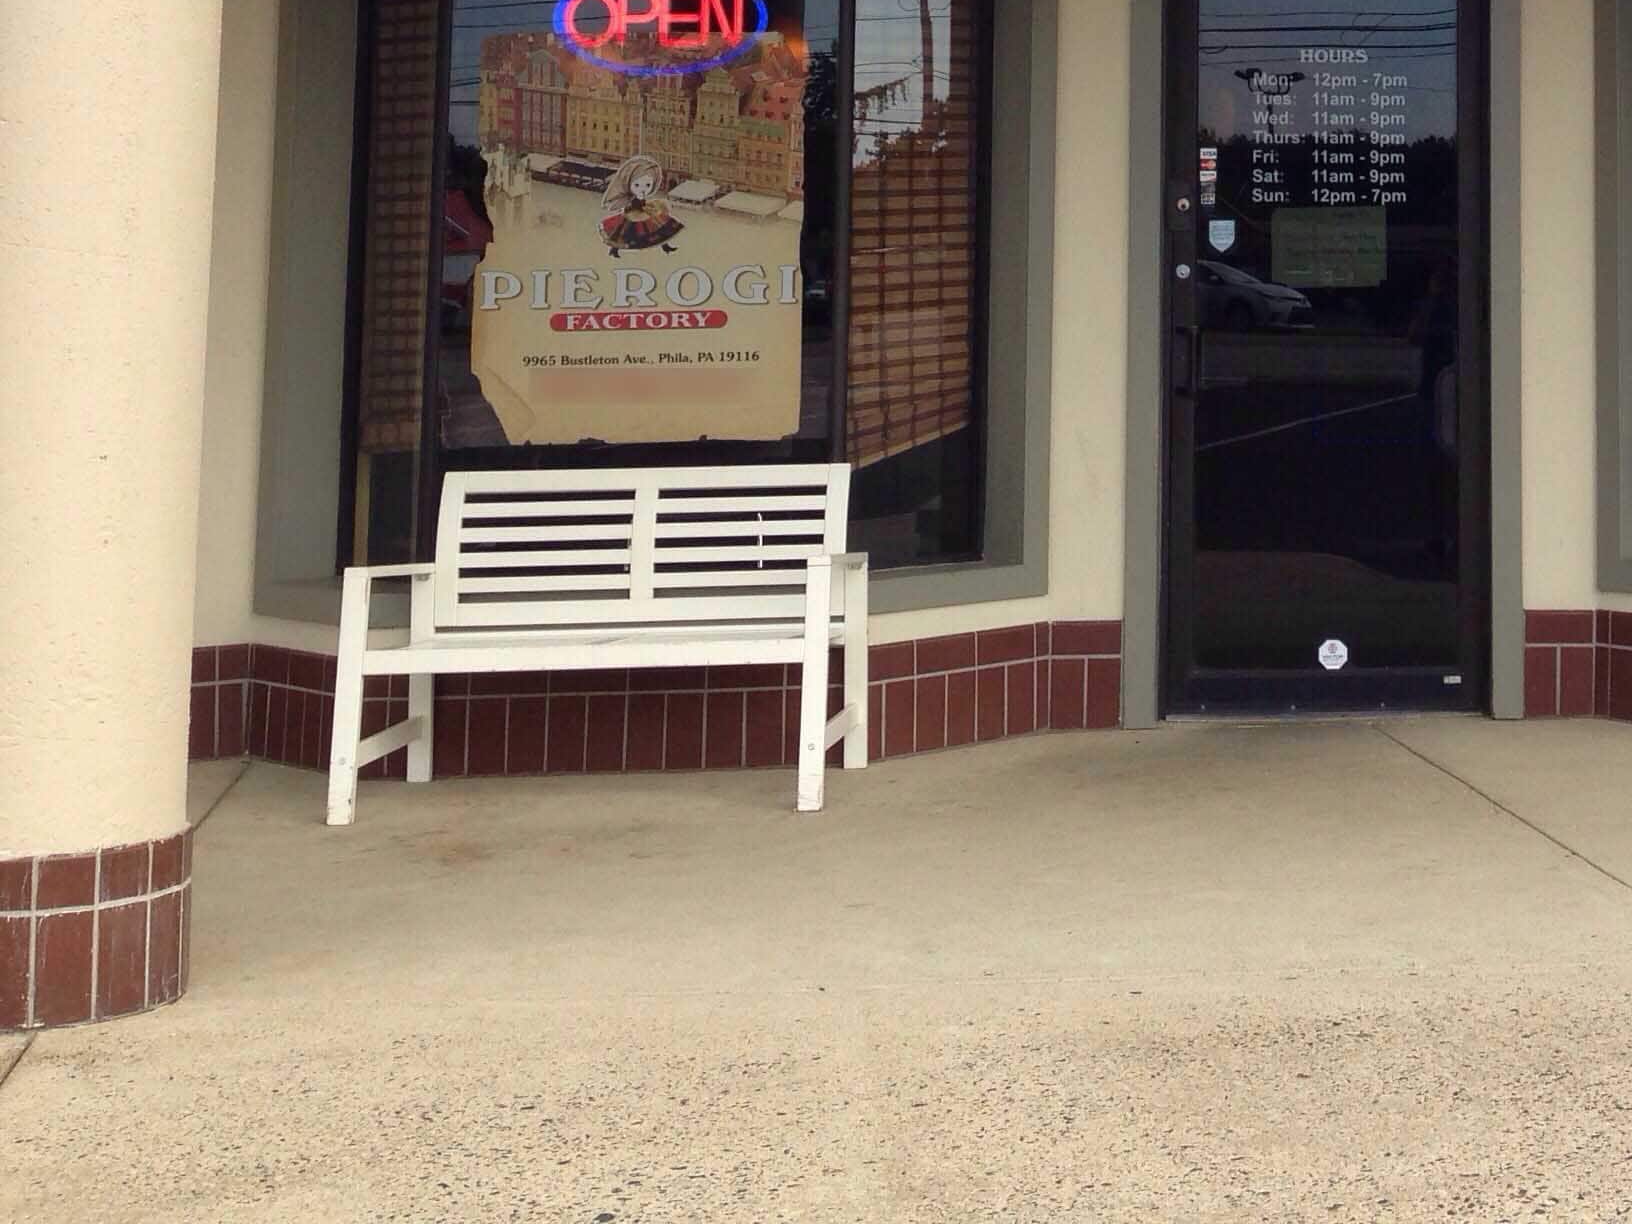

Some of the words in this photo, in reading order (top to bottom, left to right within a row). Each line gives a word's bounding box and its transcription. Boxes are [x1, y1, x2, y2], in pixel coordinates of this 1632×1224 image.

[1300, 48, 1369, 63] HOURS
[1253, 73, 1294, 87] Mon:
[1313, 73, 1357, 88] 12pm
[1373, 73, 1408, 88] 7pm
[1253, 92, 1297, 105] Tues:
[1312, 92, 1354, 105] 11am
[1370, 92, 1405, 108] 9pm
[1253, 111, 1295, 125] Wed:
[1312, 111, 1354, 125] 11am
[1370, 111, 1405, 128] 9pm
[1253, 130, 1305, 144] Thurs:
[1312, 130, 1354, 144] 11am
[1369, 131, 1405, 147] 9pm
[1252, 149, 1279, 163] Fri:
[1312, 149, 1354, 163] 11am
[1369, 150, 1405, 167] 9pm
[1252, 169, 1284, 183] Sat:
[1312, 169, 1354, 183] 11am
[1369, 169, 1405, 186] 9pm
[1252, 188, 1290, 203] Sun:
[1312, 188, 1356, 205] 12pm
[1371, 188, 1407, 205] 7pm
[480, 264, 799, 309] PIEROGI
[566, 311, 712, 330] FACTORY
[522, 354, 556, 366] 9965
[560, 354, 620, 366] Bustleton
[658, 352, 693, 364] Phila,
[697, 352, 714, 362] PA
[719, 351, 760, 362] 19116
